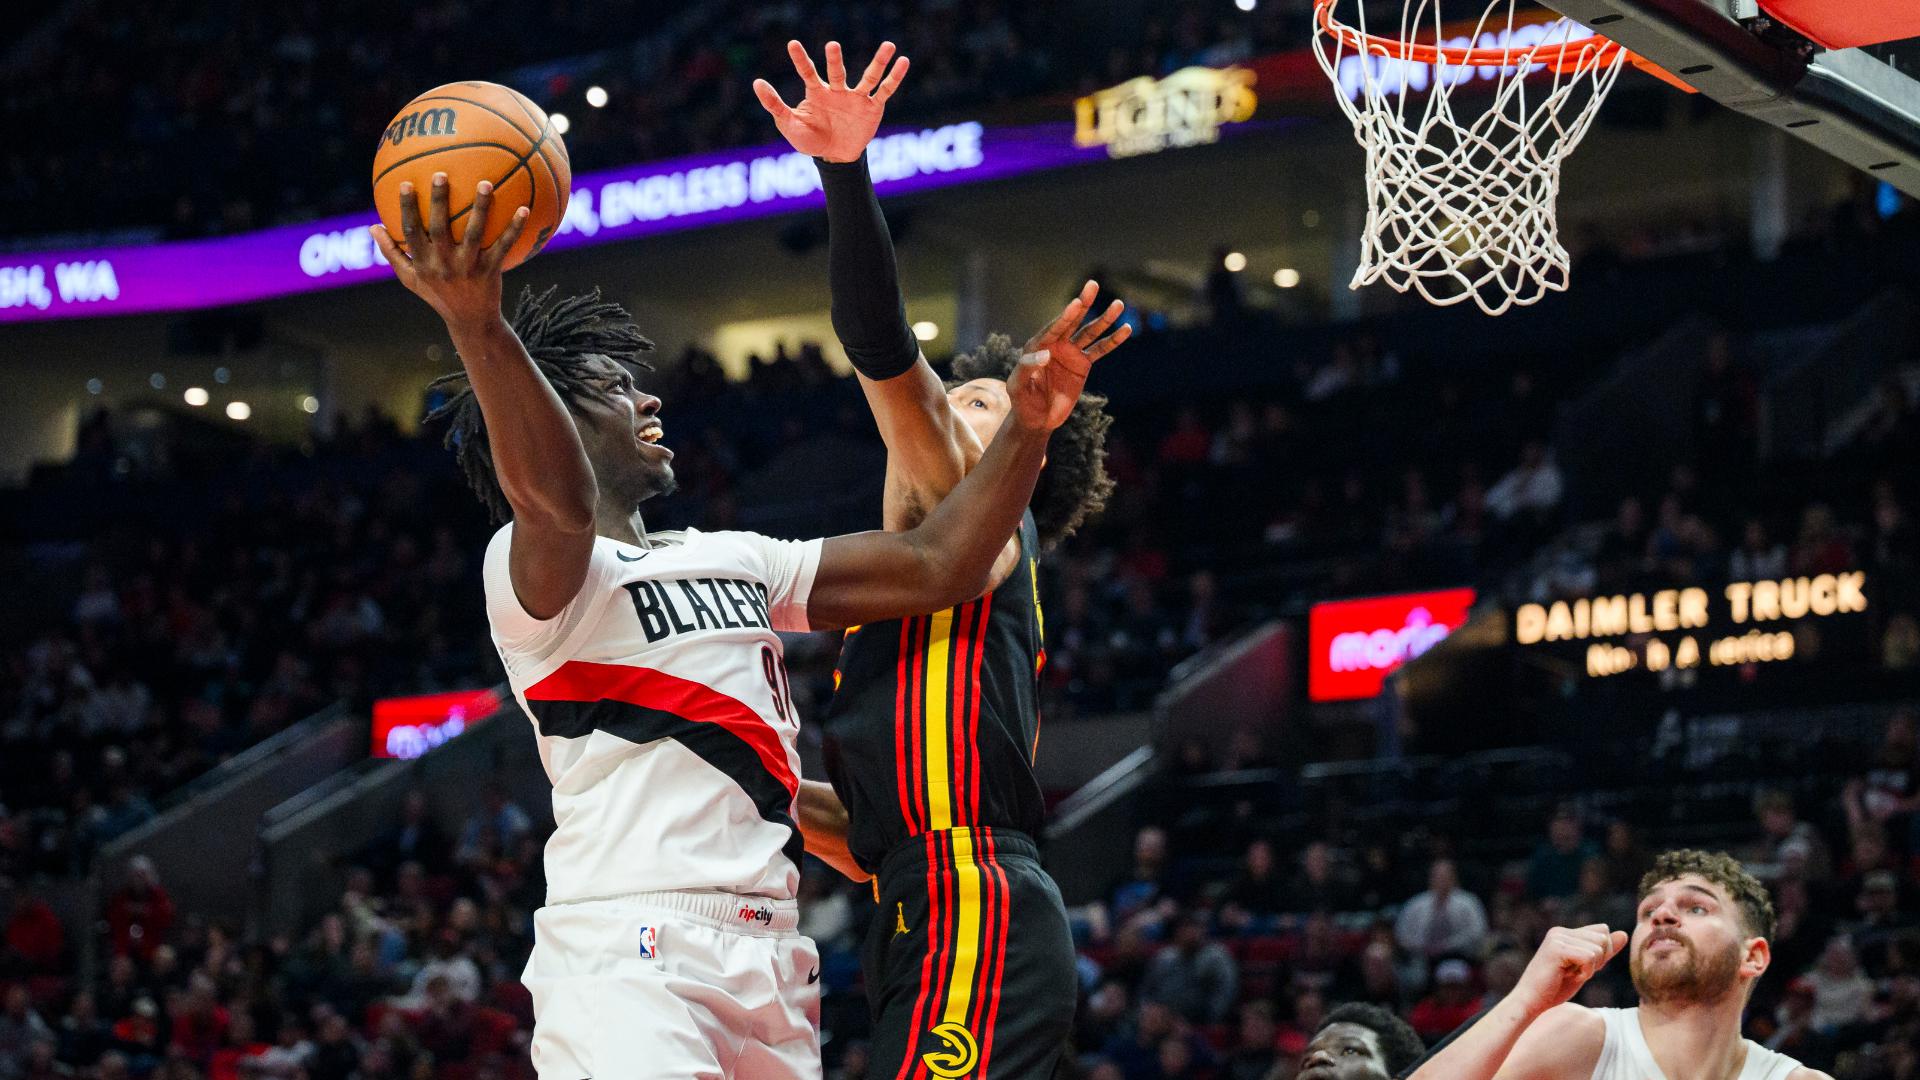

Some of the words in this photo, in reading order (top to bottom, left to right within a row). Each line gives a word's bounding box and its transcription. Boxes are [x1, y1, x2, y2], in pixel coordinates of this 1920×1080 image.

[600, 161, 749, 228] ENDLESS
[55, 259, 120, 303] WA
[1516, 587, 1709, 645] DAIMLER
[1725, 571, 1868, 624] TRUCK
